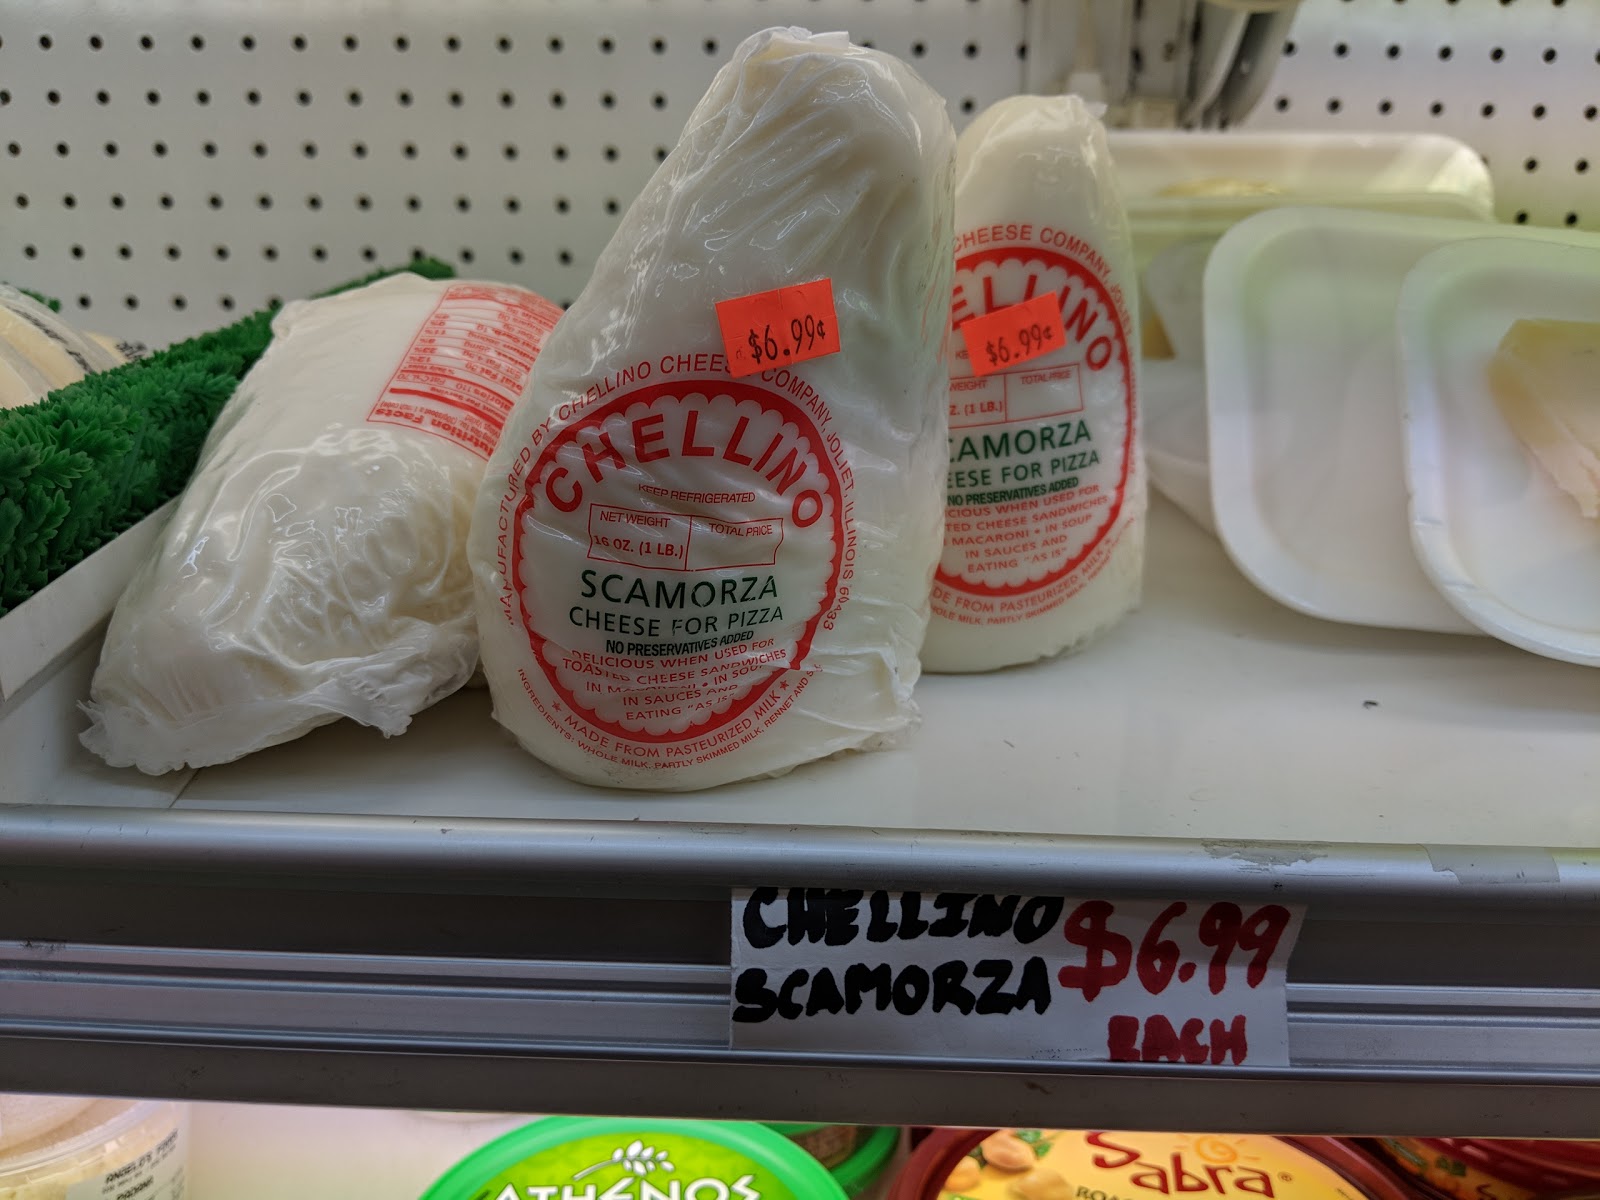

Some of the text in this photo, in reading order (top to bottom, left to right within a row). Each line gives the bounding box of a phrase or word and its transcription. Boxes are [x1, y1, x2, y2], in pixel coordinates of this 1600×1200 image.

[456, 382, 471, 392] 110
[1020, 375, 1047, 385] TOTAL
[375, 408, 425, 425] Facts
[964, 403, 976, 417] (1
[980, 400, 1004, 414] LB.)
[531, 416, 552, 447] BY
[557, 361, 652, 421] CHELLINO
[660, 352, 754, 378] CHEE
[761, 367, 833, 433] COMPANY,
[826, 432, 855, 499] JOLIET,
[843, 500, 858, 581] ILLINOIS
[545, 409, 824, 529] CHELLINO
[1002, 462, 1043, 484] FOR
[1051, 450, 1100, 476] PIZZA
[638, 483, 757, 505] KEEP REFRIGERATED
[947, 476, 1080, 507] NO PRESERVATIVES ADDED
[995, 501, 1039, 514] WHEN
[1043, 491, 1075, 505] USED
[1078, 484, 1100, 497] FOR
[600, 510, 671, 528] NET WEIGHT
[976, 516, 1028, 531] CHEESE
[1032, 495, 1109, 523] SANDWICHES
[709, 522, 773, 538] TOTAL PRICE
[951, 529, 1030, 546] MACARONI
[1045, 523, 1058, 534] IN
[1062, 513, 1093, 530] SOUP
[594, 535, 684, 560] 16 OZ. (1 LB.)
[965, 534, 1068, 559] IN SAUCES AND
[967, 559, 1018, 574] EATING
[581, 569, 778, 609] SCAMORZA
[933, 586, 951, 604] DE
[954, 596, 995, 614] FROM
[1000, 574, 1079, 613] PASTEURIZED
[569, 606, 783, 637] CHEESE FOR PIZZA
[986, 612, 1023, 625] PARTLY
[571, 638, 774, 669] DELICIOUS WHEN USED FOR
[606, 630, 754, 657] NO PRESERVATIVES ADDED
[562, 657, 631, 682] TOASTED
[636, 670, 695, 685] CHEESE
[700, 648, 787, 677] SANDWICHES
[586, 681, 601, 693] IN
[714, 675, 728, 686] IN
[732, 664, 763, 679] SOU
[623, 696, 639, 706] IN
[644, 689, 701, 705] SAUCES
[706, 684, 738, 696] AND
[518, 668, 575, 743] INGREDIENTS:
[577, 740, 618, 763] WHOLE
[654, 758, 693, 769] PARTLY
[696, 741, 741, 764] SKIMMED
[741, 726, 765, 745] MILK,
[763, 697, 795, 728] RENNET
[793, 679, 809, 697] AND
[564, 689, 781, 758] MADE FROM PASTEURIZED MILK
[625, 706, 682, 721] EATING
[743, 886, 1292, 1003] CHELLINO $6.99
[732, 955, 1052, 1023] SCAMORZA
[1106, 1013, 1248, 1066] EACH
[1084, 1131, 1275, 1198] Sabra
